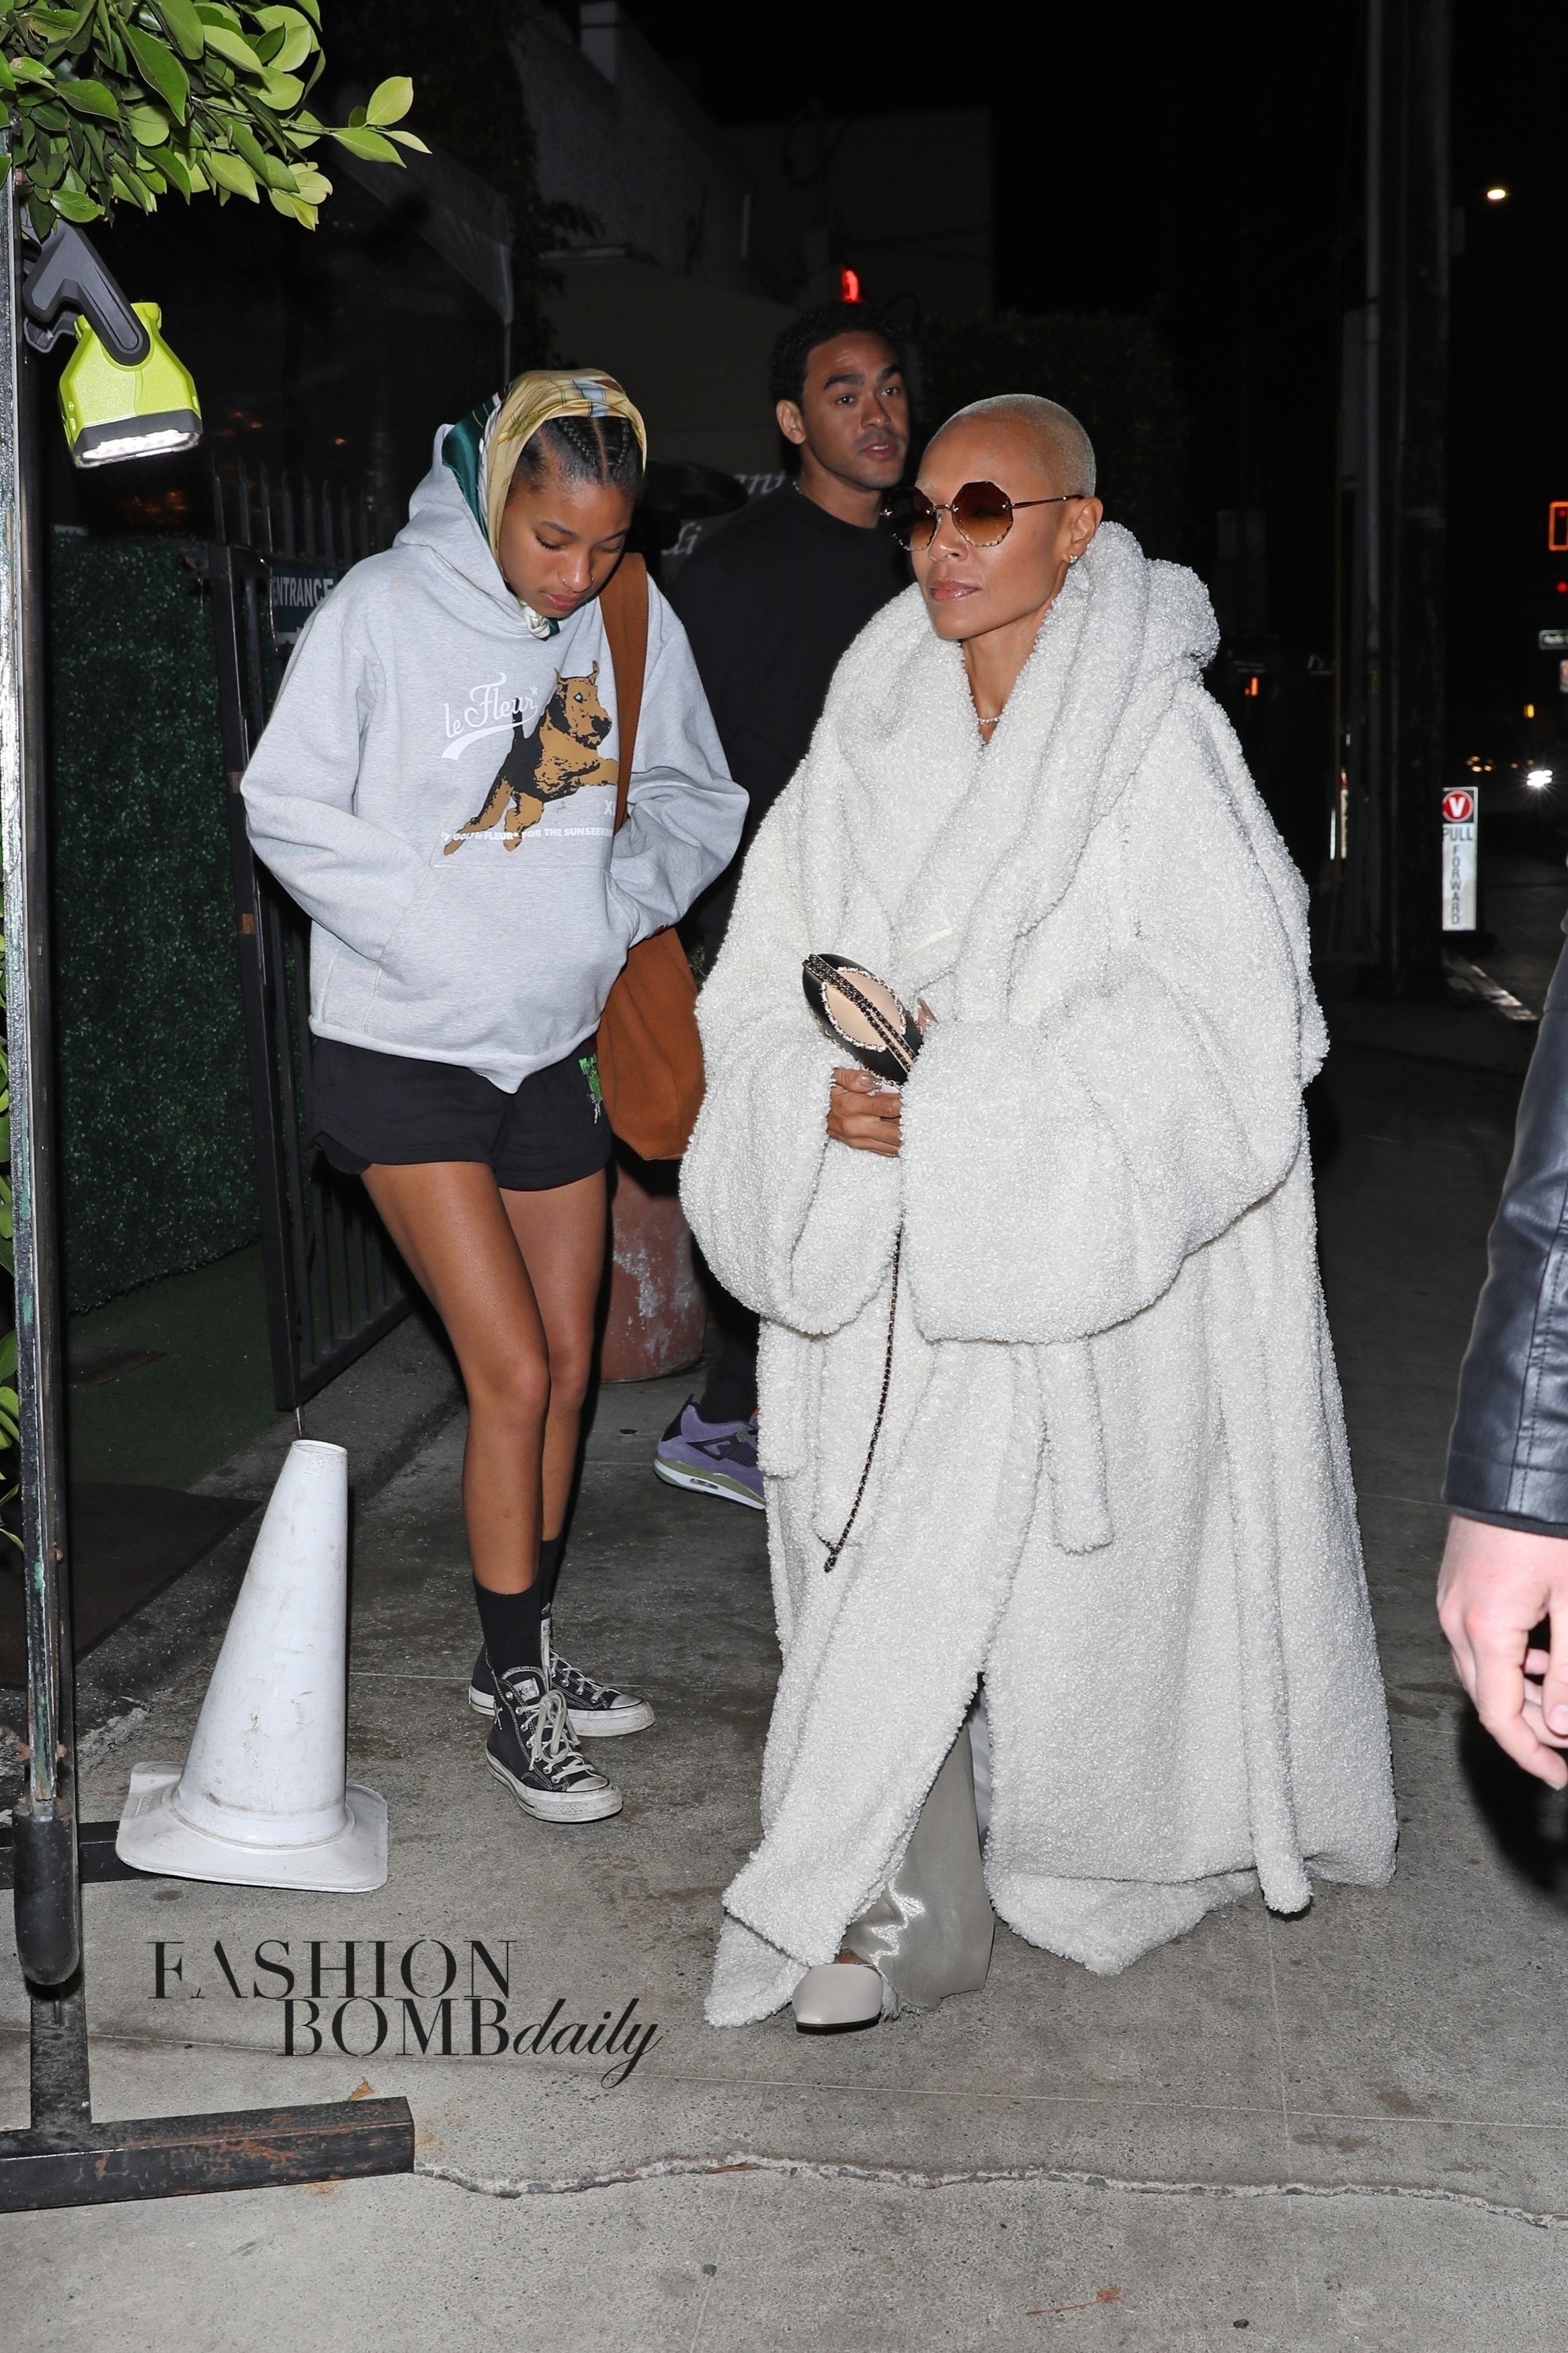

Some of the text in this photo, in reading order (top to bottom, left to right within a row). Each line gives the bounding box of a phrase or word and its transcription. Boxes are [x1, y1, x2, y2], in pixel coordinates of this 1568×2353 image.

[272, 575, 335, 607] ENTRANCE
[444, 703, 464, 739] le
[1448, 796, 1467, 818] V
[522, 829, 542, 839] FOR
[543, 828, 562, 836] THE
[1443, 827, 1473, 842] PULL
[1450, 844, 1462, 924] FORWARD
